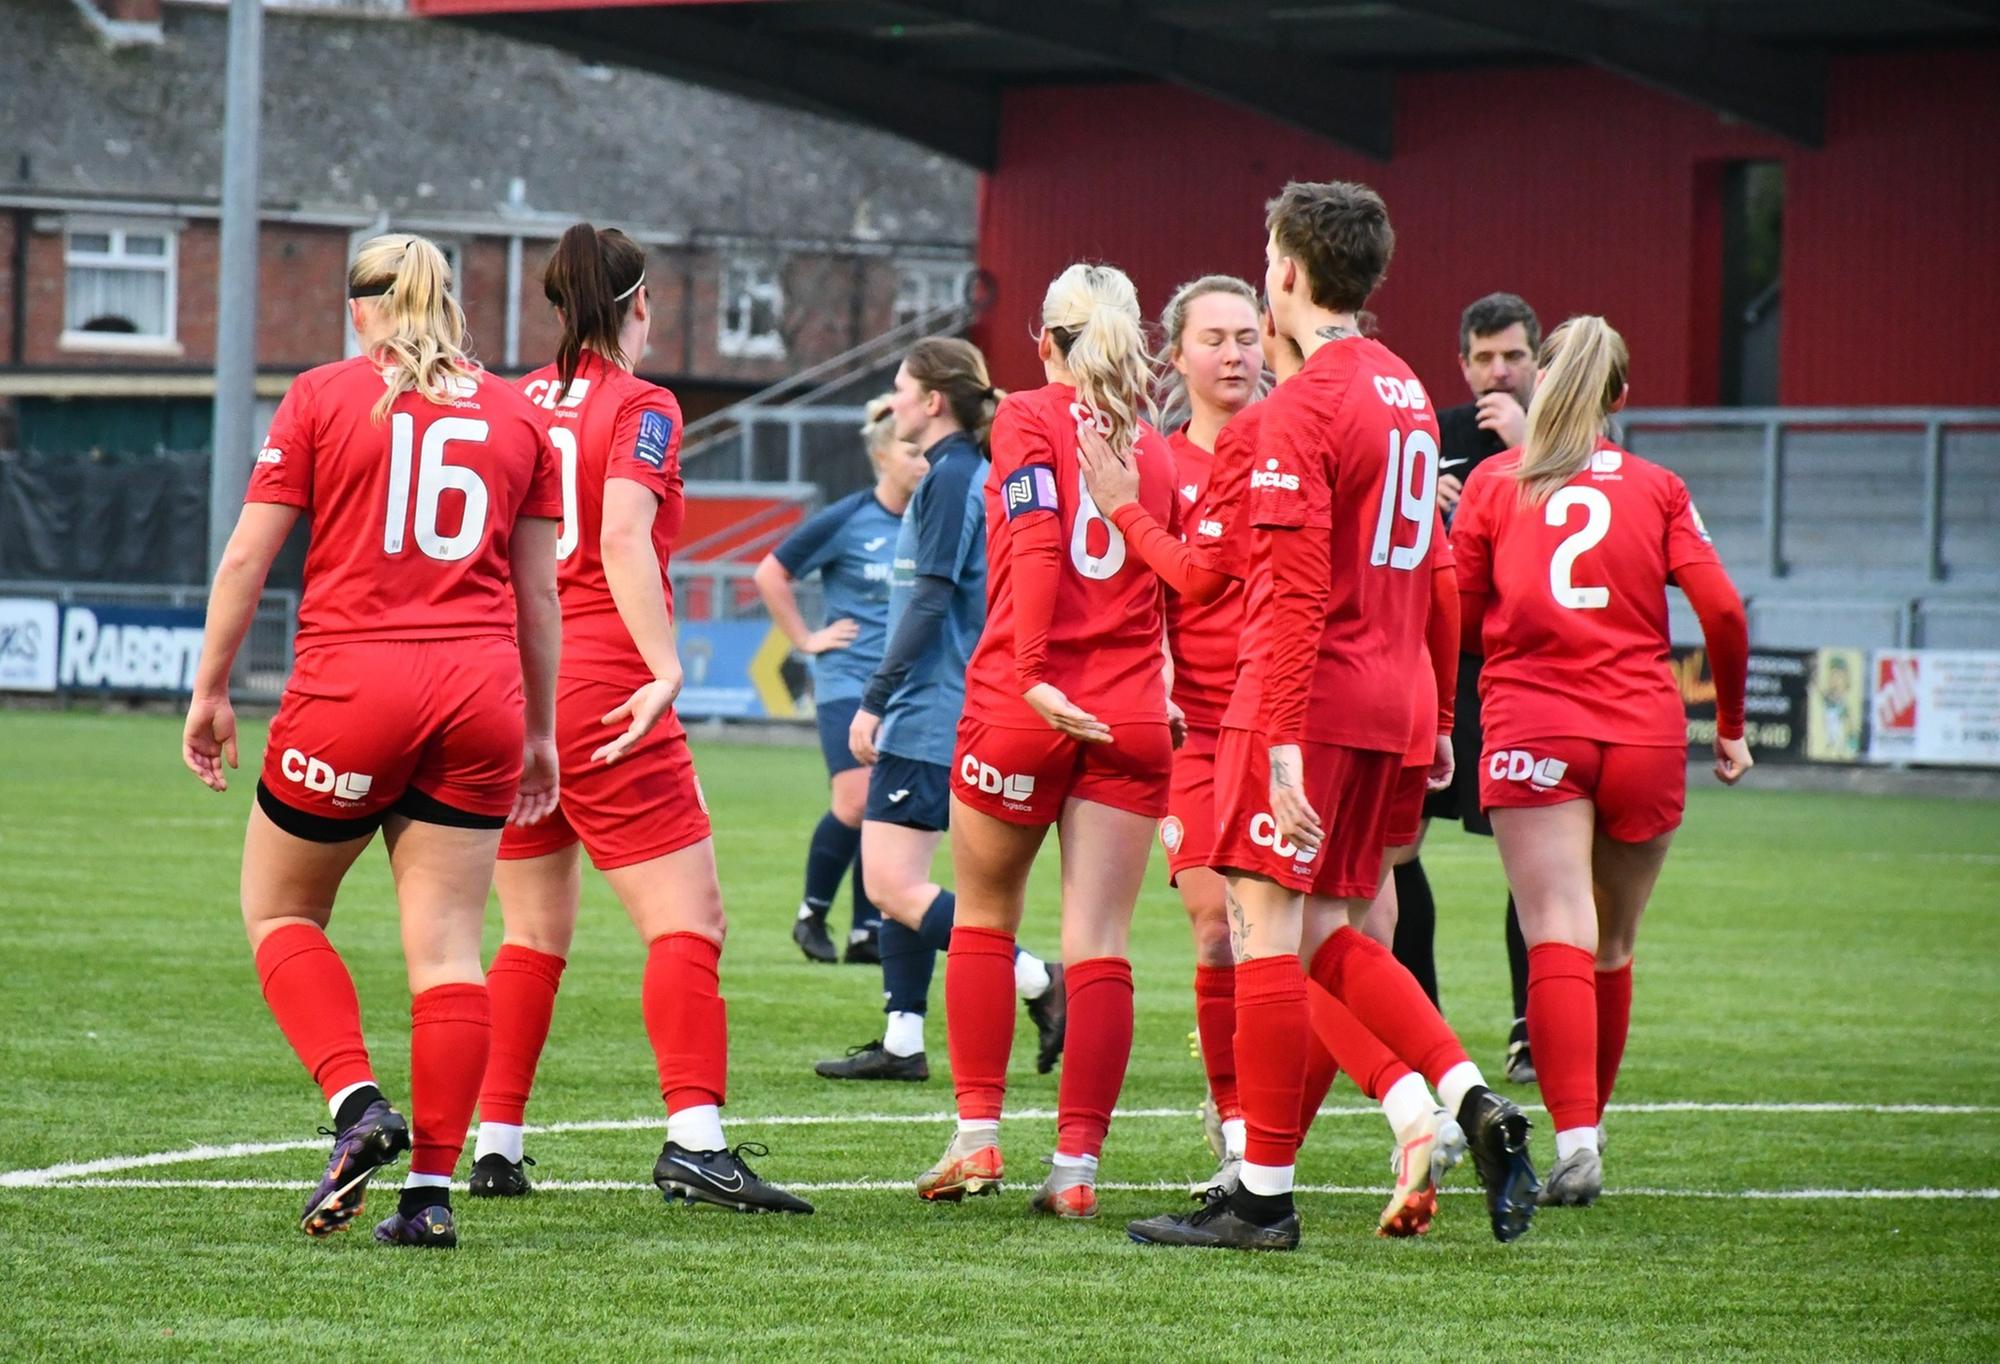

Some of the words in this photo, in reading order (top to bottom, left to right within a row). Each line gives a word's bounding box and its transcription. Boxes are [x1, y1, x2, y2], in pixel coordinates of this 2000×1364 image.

[384, 412, 489, 561] 16
[1370, 428, 1439, 571] 19
[1545, 485, 1611, 609] 2
